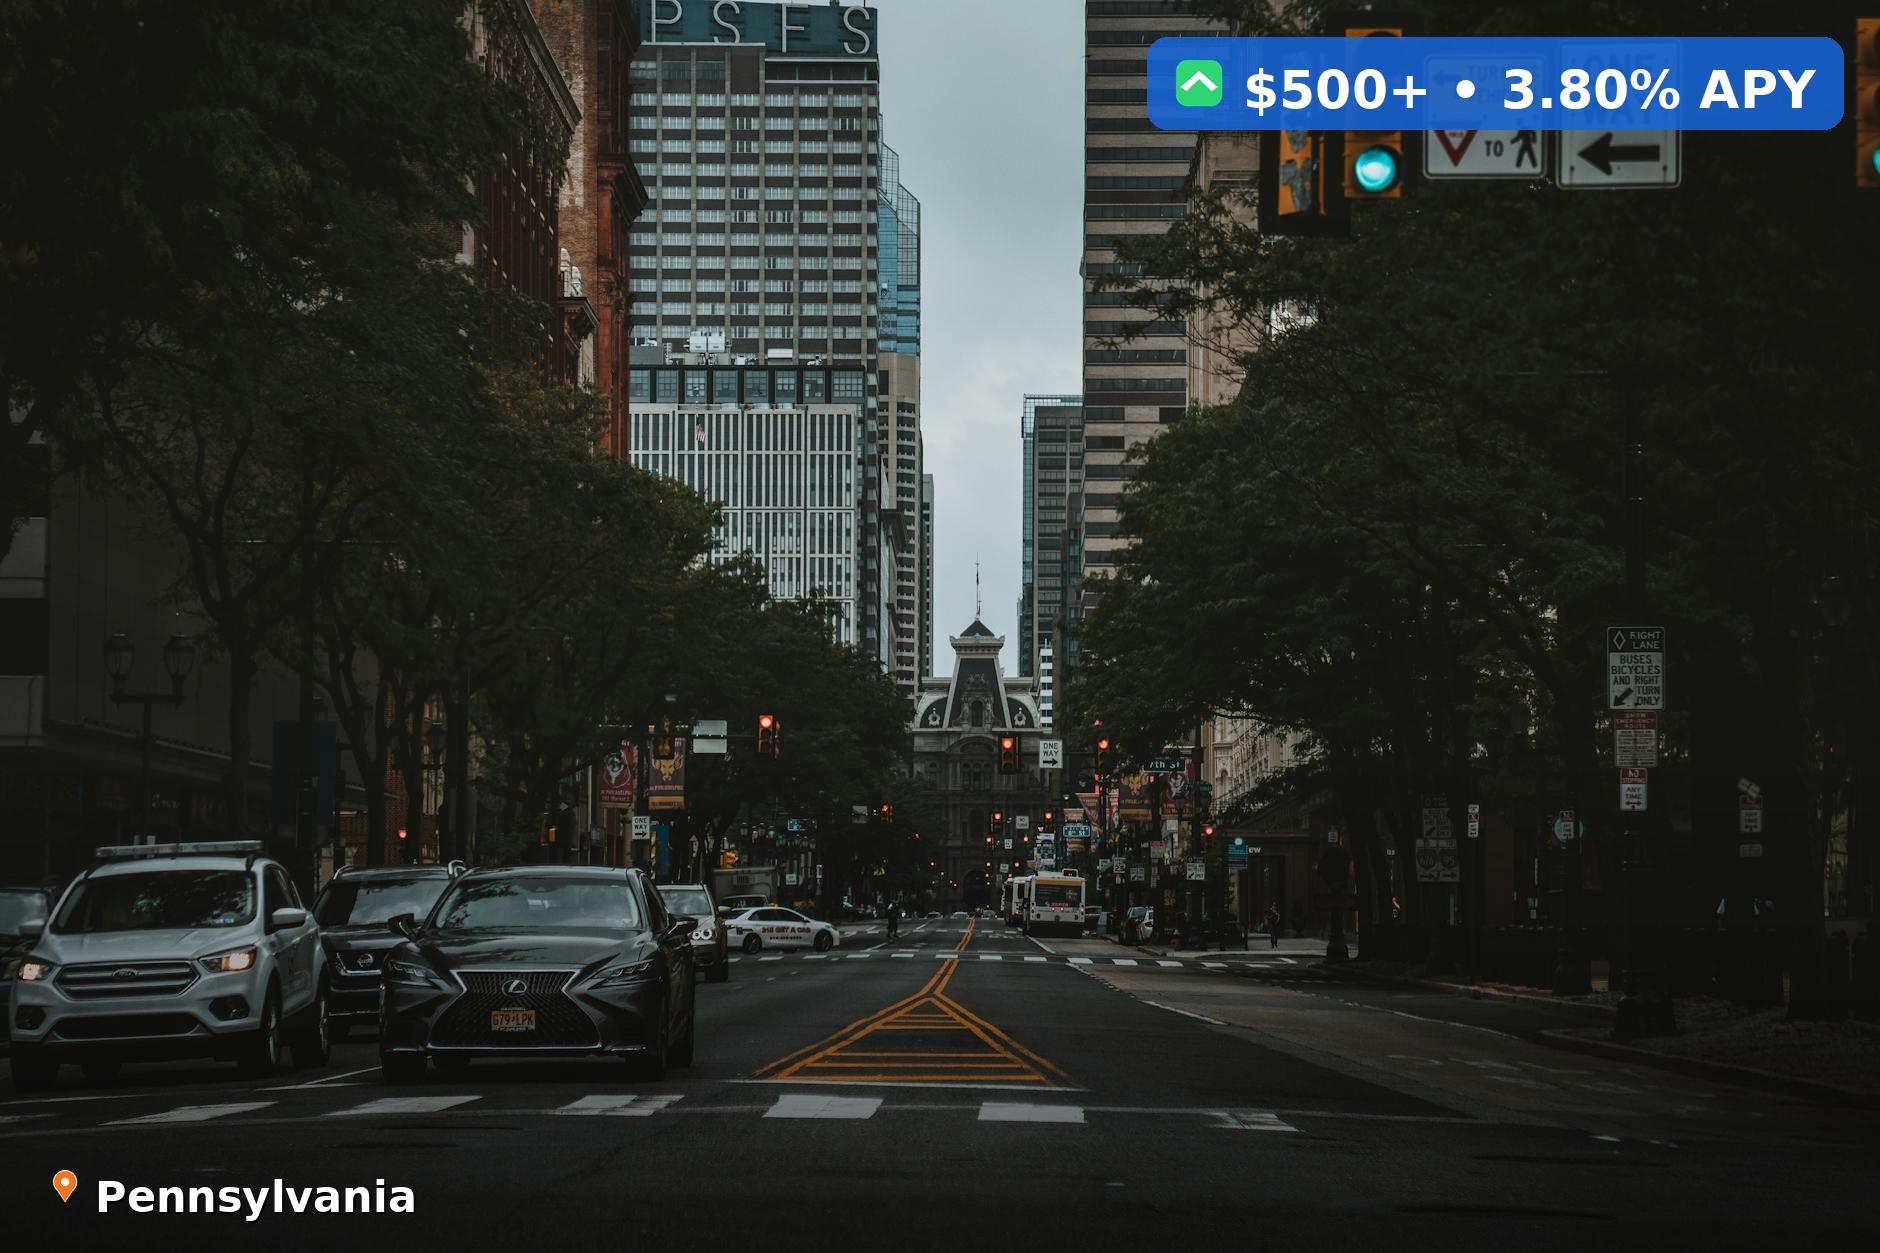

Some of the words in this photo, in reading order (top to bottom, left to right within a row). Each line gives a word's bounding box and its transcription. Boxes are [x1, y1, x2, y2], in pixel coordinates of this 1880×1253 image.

[650, 0, 871, 55] PSFS
[1484, 140, 1504, 157] TO
[1633, 640, 1660, 649] LANE
[1620, 655, 1652, 664] BUSES
[1611, 665, 1661, 675] BICYCLES
[1614, 676, 1631, 685] AND
[1635, 675, 1658, 685] RIGHT
[1637, 685, 1660, 695] TURN
[1637, 696, 1660, 705] ONLY
[1043, 742, 1059, 750] ONE
[1628, 769, 1640, 778] NO
